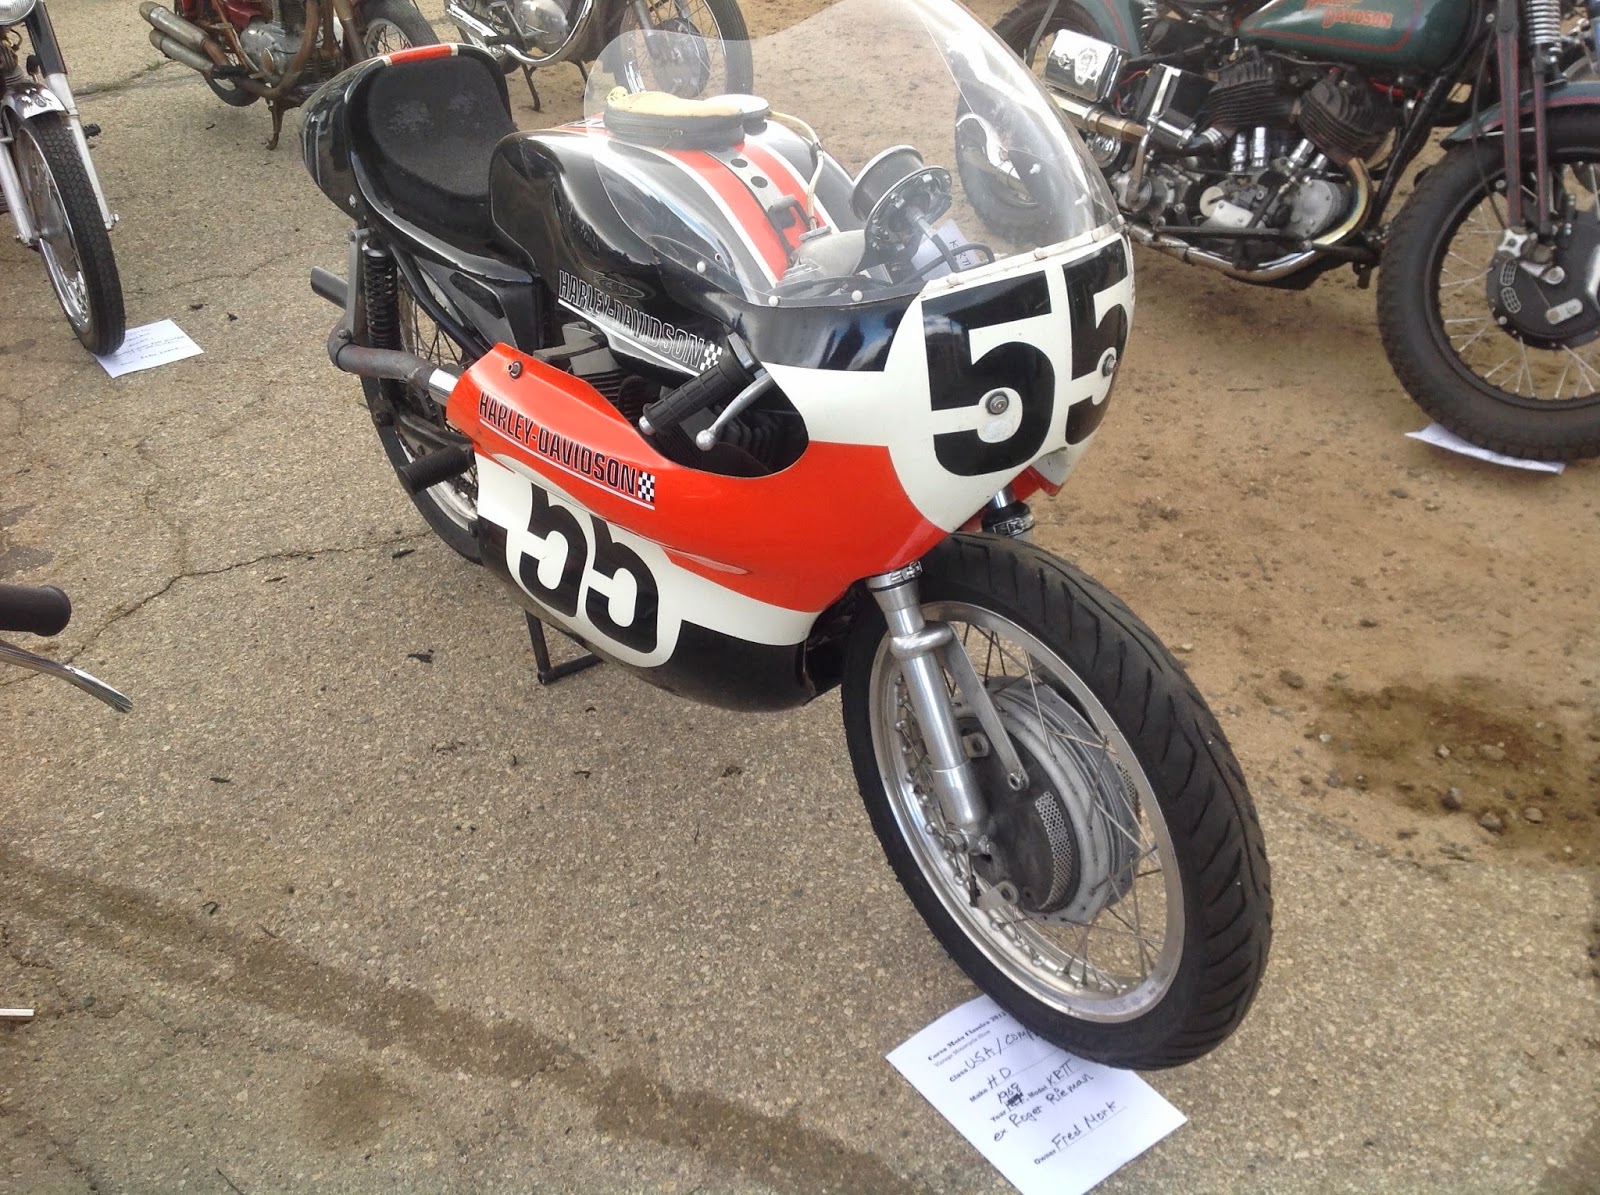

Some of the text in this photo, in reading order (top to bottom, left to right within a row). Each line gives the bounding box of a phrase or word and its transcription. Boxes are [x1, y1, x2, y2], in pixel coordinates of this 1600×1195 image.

[558, 269, 705, 368] HARLEY-DAVIDSON
[921, 238, 1128, 476] 55
[479, 390, 637, 496] HARLEY-DAVIDSON
[519, 482, 659, 654] 55
[947, 1034, 965, 1049] Moto
[949, 1068, 969, 1082] Class
[969, 1088, 989, 1103] Make
[990, 1110, 1007, 1122] Year
[1027, 1085, 1048, 1099] Model
[993, 1128, 1008, 1142] ex
[1008, 1105, 1043, 1128] Roger
[1034, 1149, 1056, 1165] Owner
[1051, 1124, 1082, 1151] Fred
